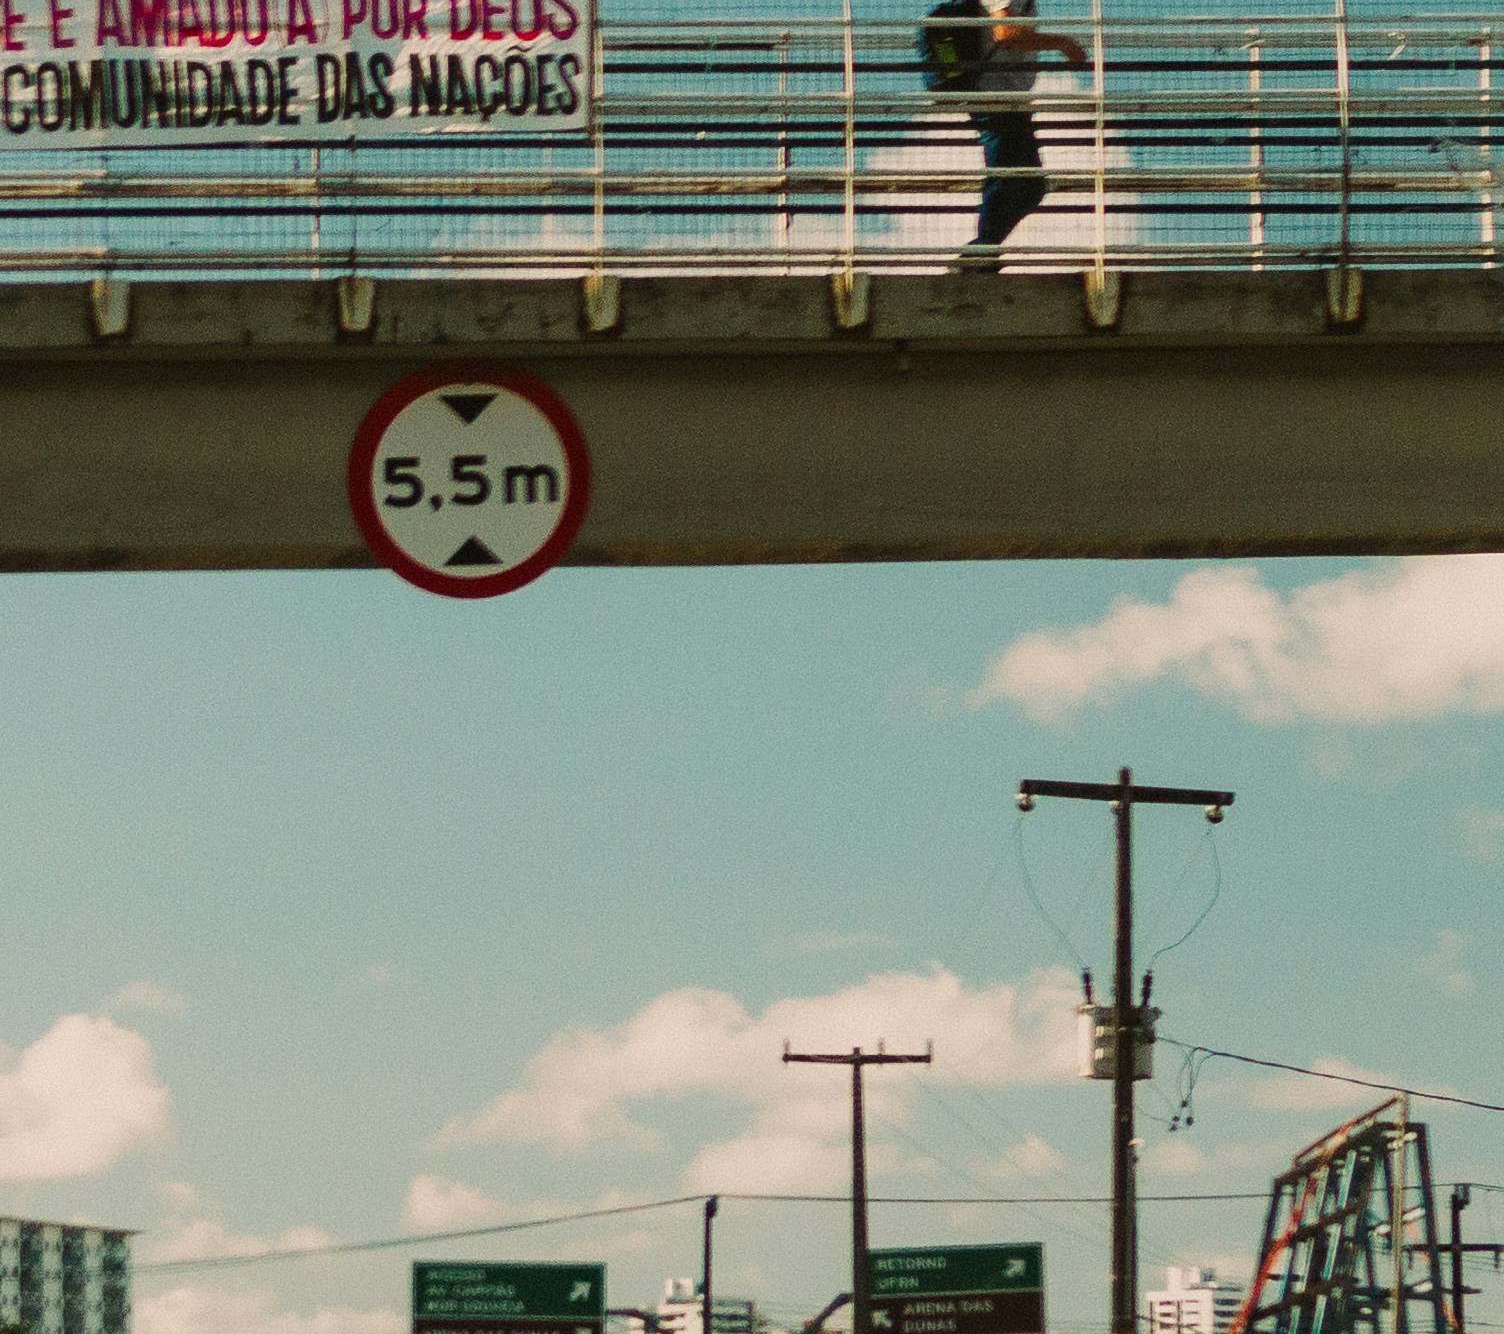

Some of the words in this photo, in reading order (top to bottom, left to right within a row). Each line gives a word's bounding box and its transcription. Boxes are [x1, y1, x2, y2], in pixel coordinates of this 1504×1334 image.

[1, 55, 300, 136] COMUNIDADE
[318, 52, 393, 123] DAS
[409, 45, 580, 126] NAÇÕES
[383, 455, 560, 512] 5,5m
[876, 1257, 947, 1271] RETORNO
